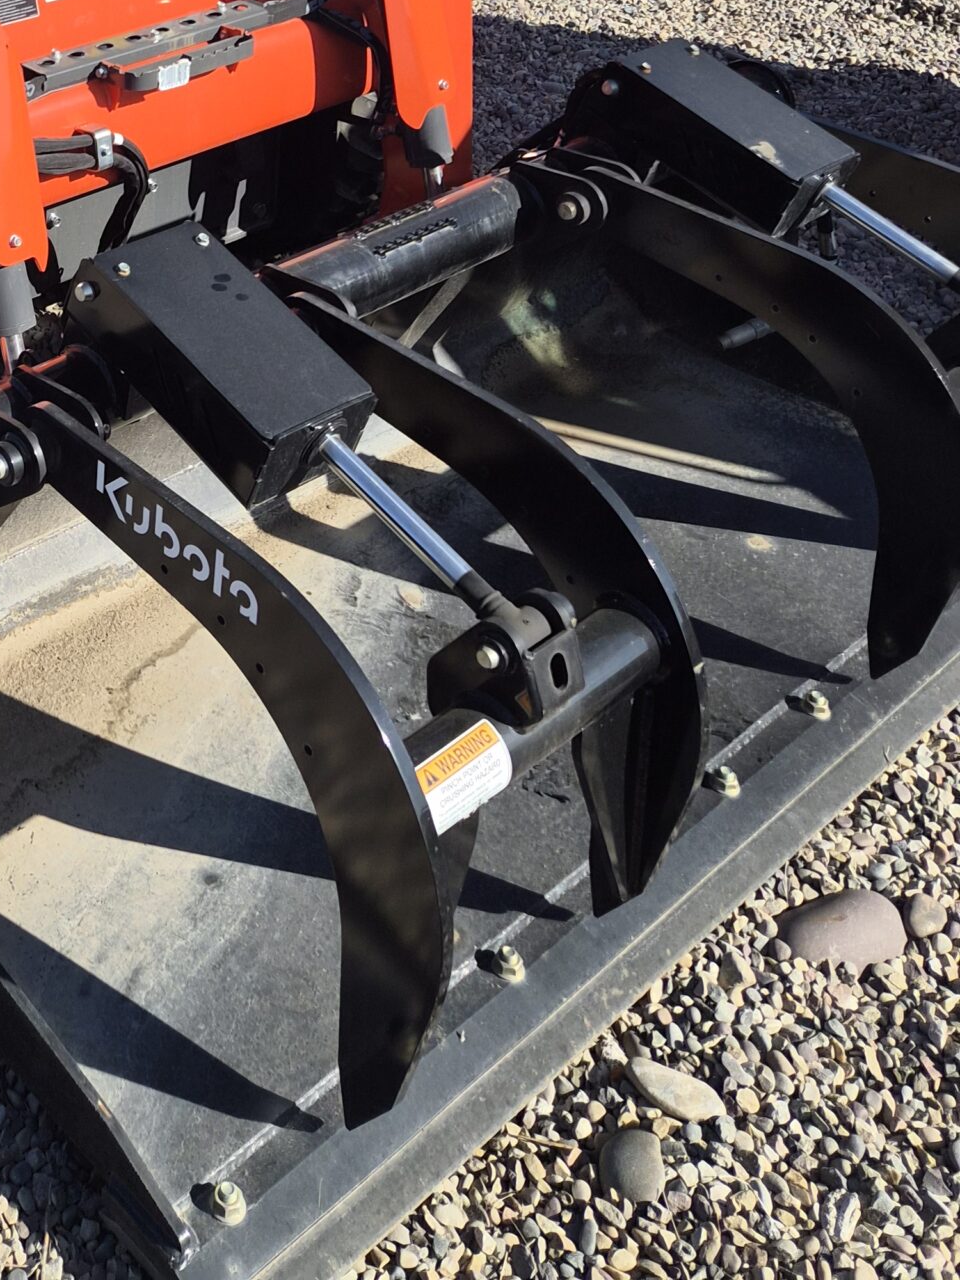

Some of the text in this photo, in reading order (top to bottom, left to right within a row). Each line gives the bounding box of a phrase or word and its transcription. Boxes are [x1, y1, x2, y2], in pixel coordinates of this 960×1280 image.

[96, 459, 259, 626] Kubota
[434, 728, 493, 776] WARNING
[440, 753, 494, 794] PINCH POINT OR
